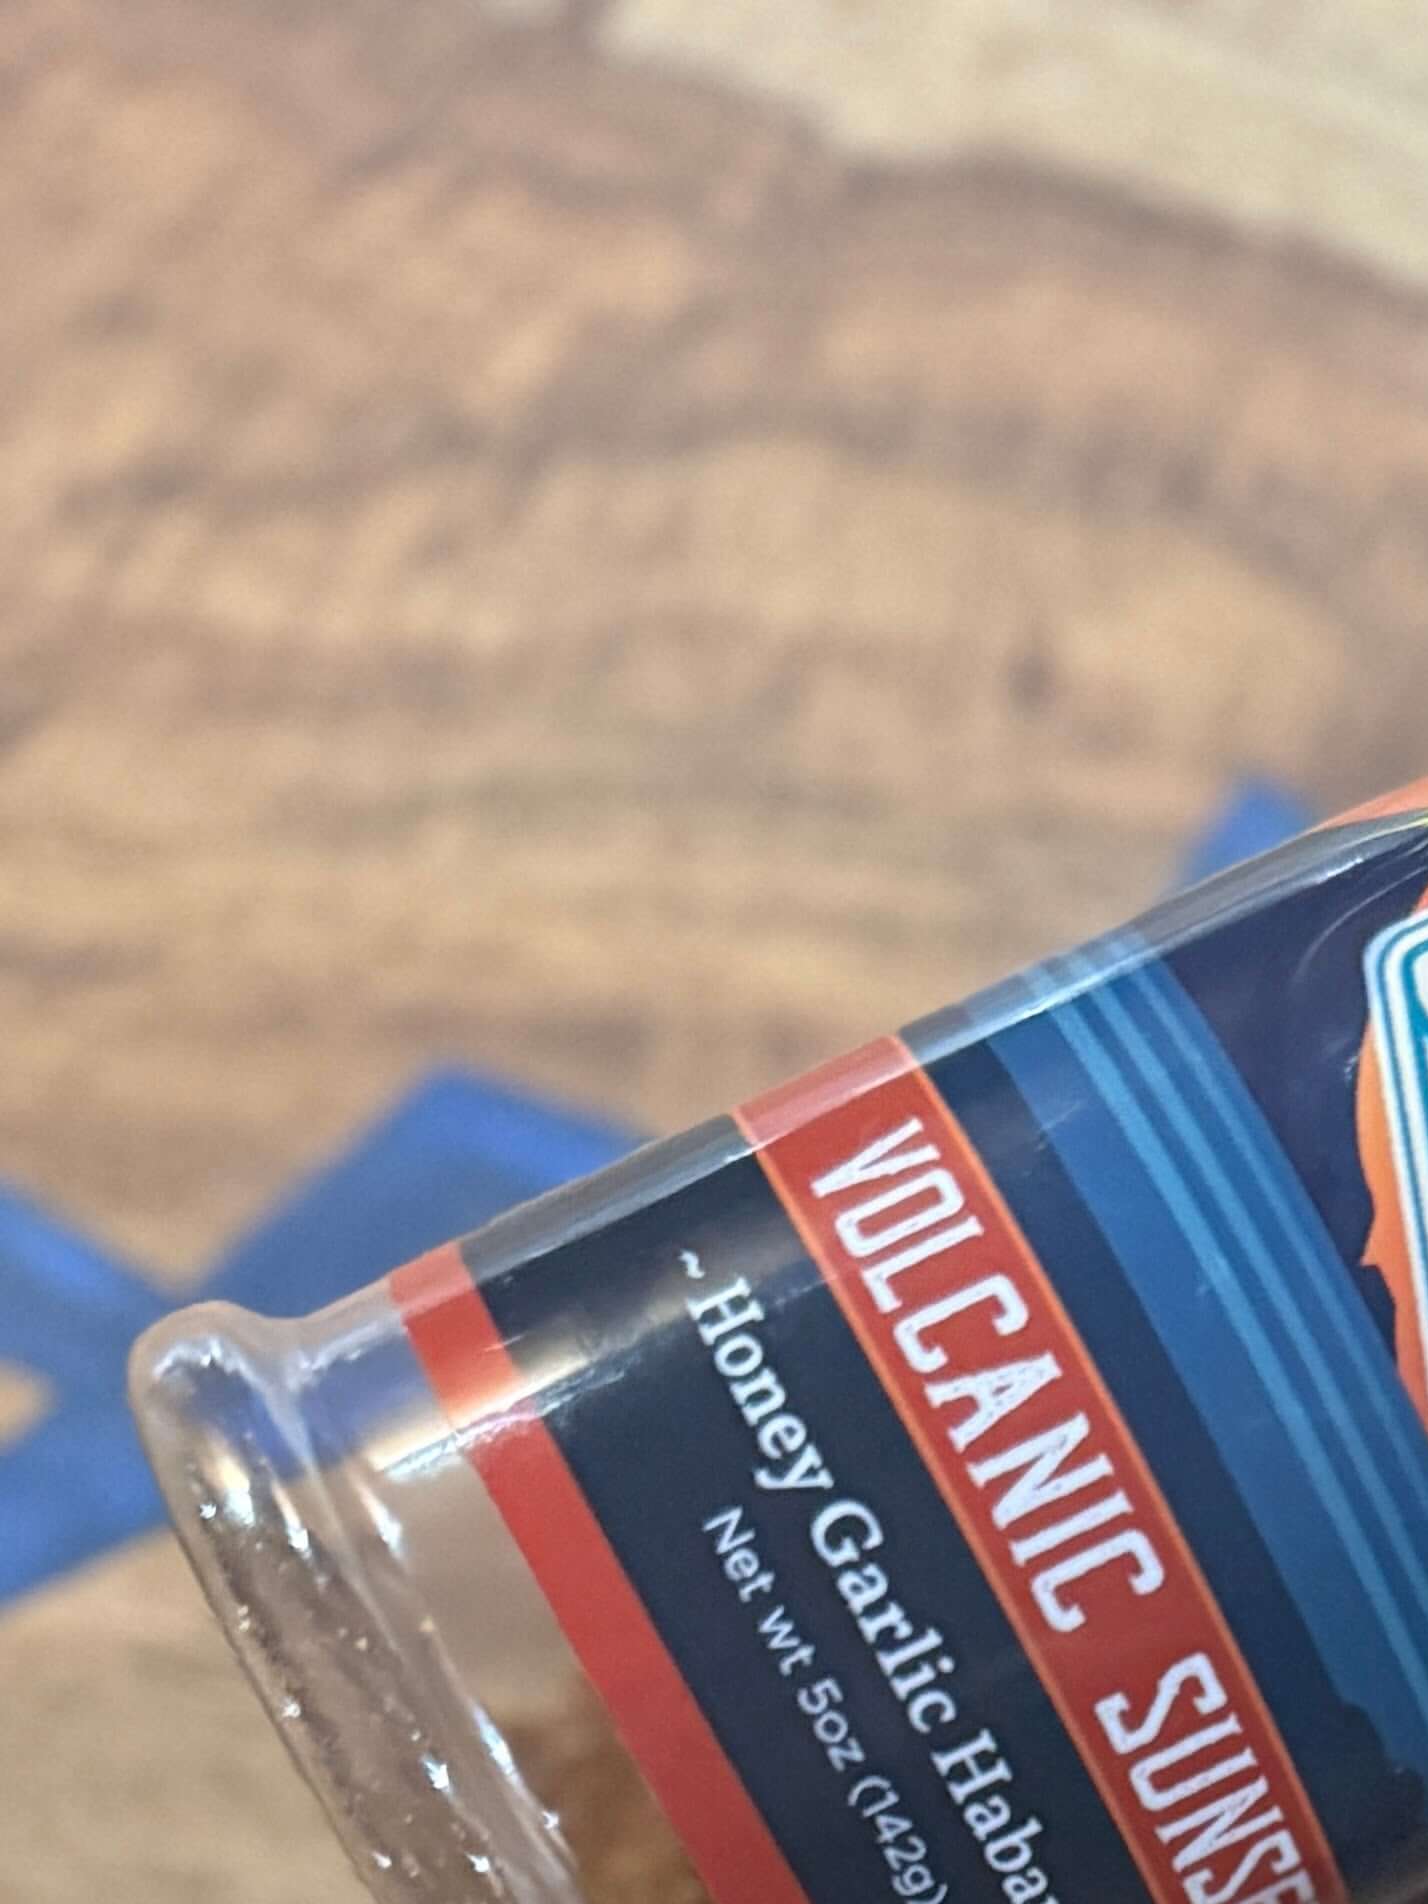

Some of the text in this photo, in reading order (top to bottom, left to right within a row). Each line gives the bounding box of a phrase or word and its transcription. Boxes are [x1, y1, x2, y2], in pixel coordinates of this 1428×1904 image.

[809, 1116, 1165, 1633] VOLCANIC
[702, 1506, 776, 1603] Net
[756, 1604, 817, 1678] wt
[797, 1676, 866, 1772] 5oz
[809, 1498, 957, 1733] Garlic
